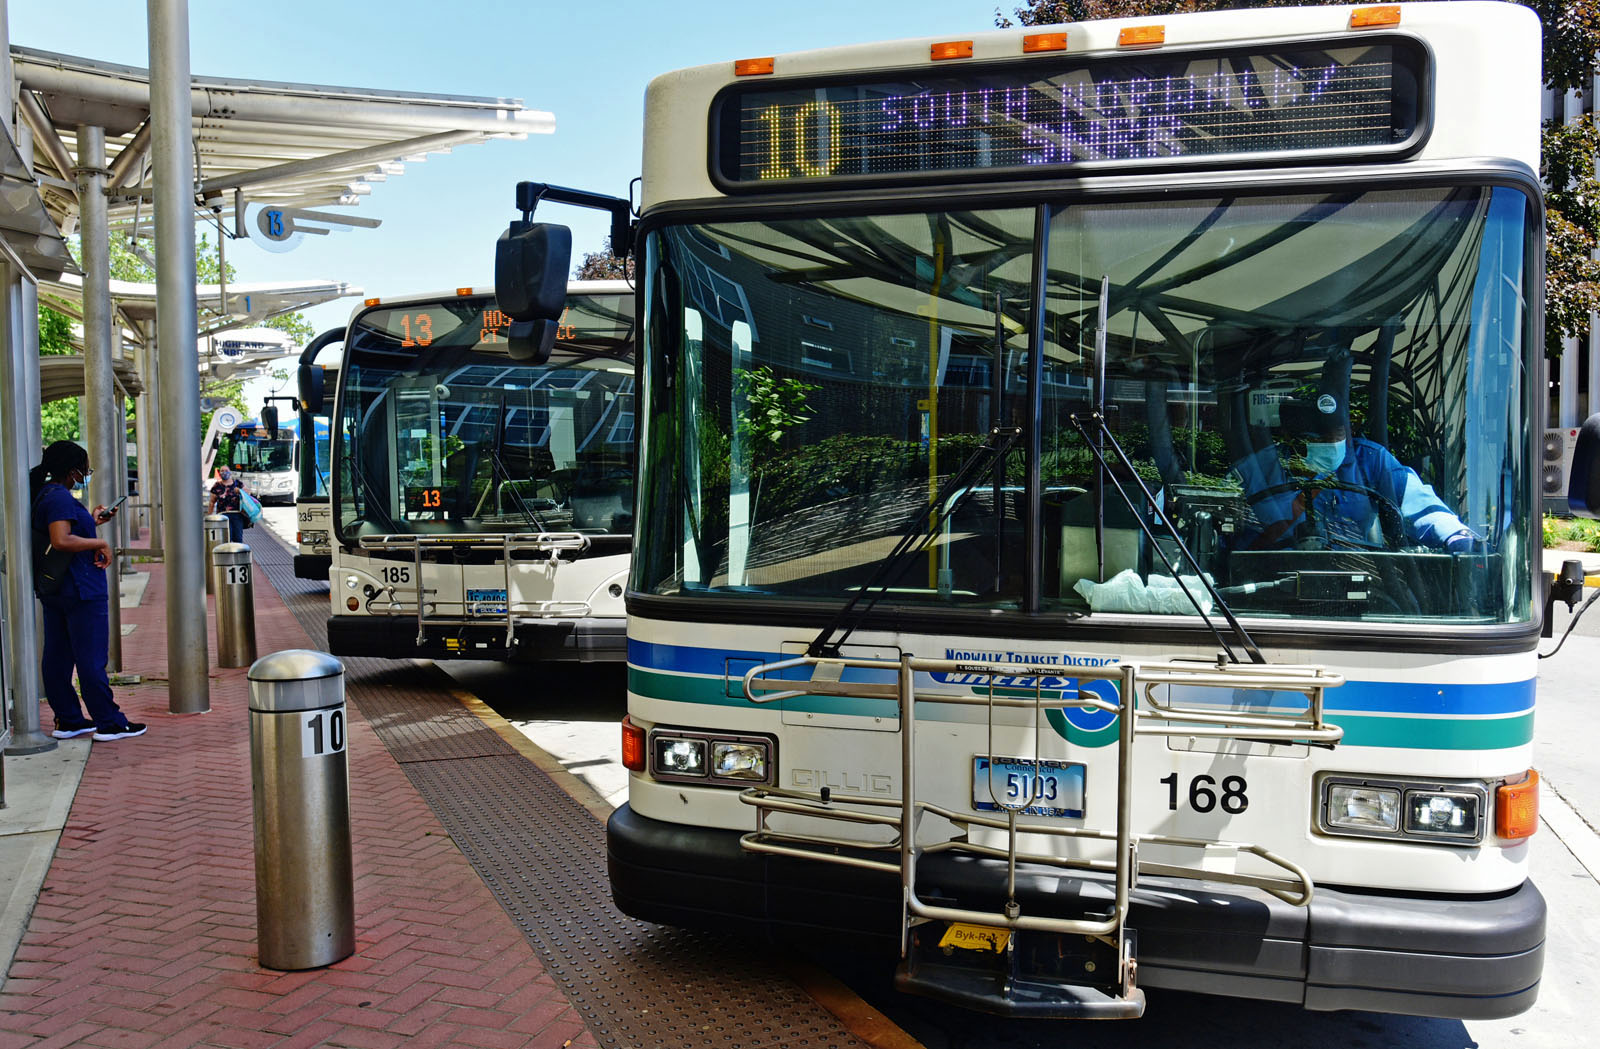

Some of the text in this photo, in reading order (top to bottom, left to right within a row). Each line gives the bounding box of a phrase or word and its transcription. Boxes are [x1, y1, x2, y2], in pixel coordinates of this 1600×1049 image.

[760, 101, 841, 179] 10
[882, 86, 1028, 130] SOUTH
[267, 210, 285, 237] 13
[245, 295, 251, 312] 1
[400, 313, 433, 348] 13
[214, 339, 265, 349] HIGHLAND
[422, 489, 441, 507] 13
[228, 565, 248, 584] 13
[381, 566, 410, 583] 185
[945, 648, 1002, 662] NORWALK
[1006, 651, 1058, 665] TRANSIT
[307, 709, 345, 755] 10
[1004, 763, 1056, 774] Connecicut
[791, 768, 892, 794] GILLIG
[1007, 773, 1058, 801] 5103
[1159, 772, 1249, 815] 168
